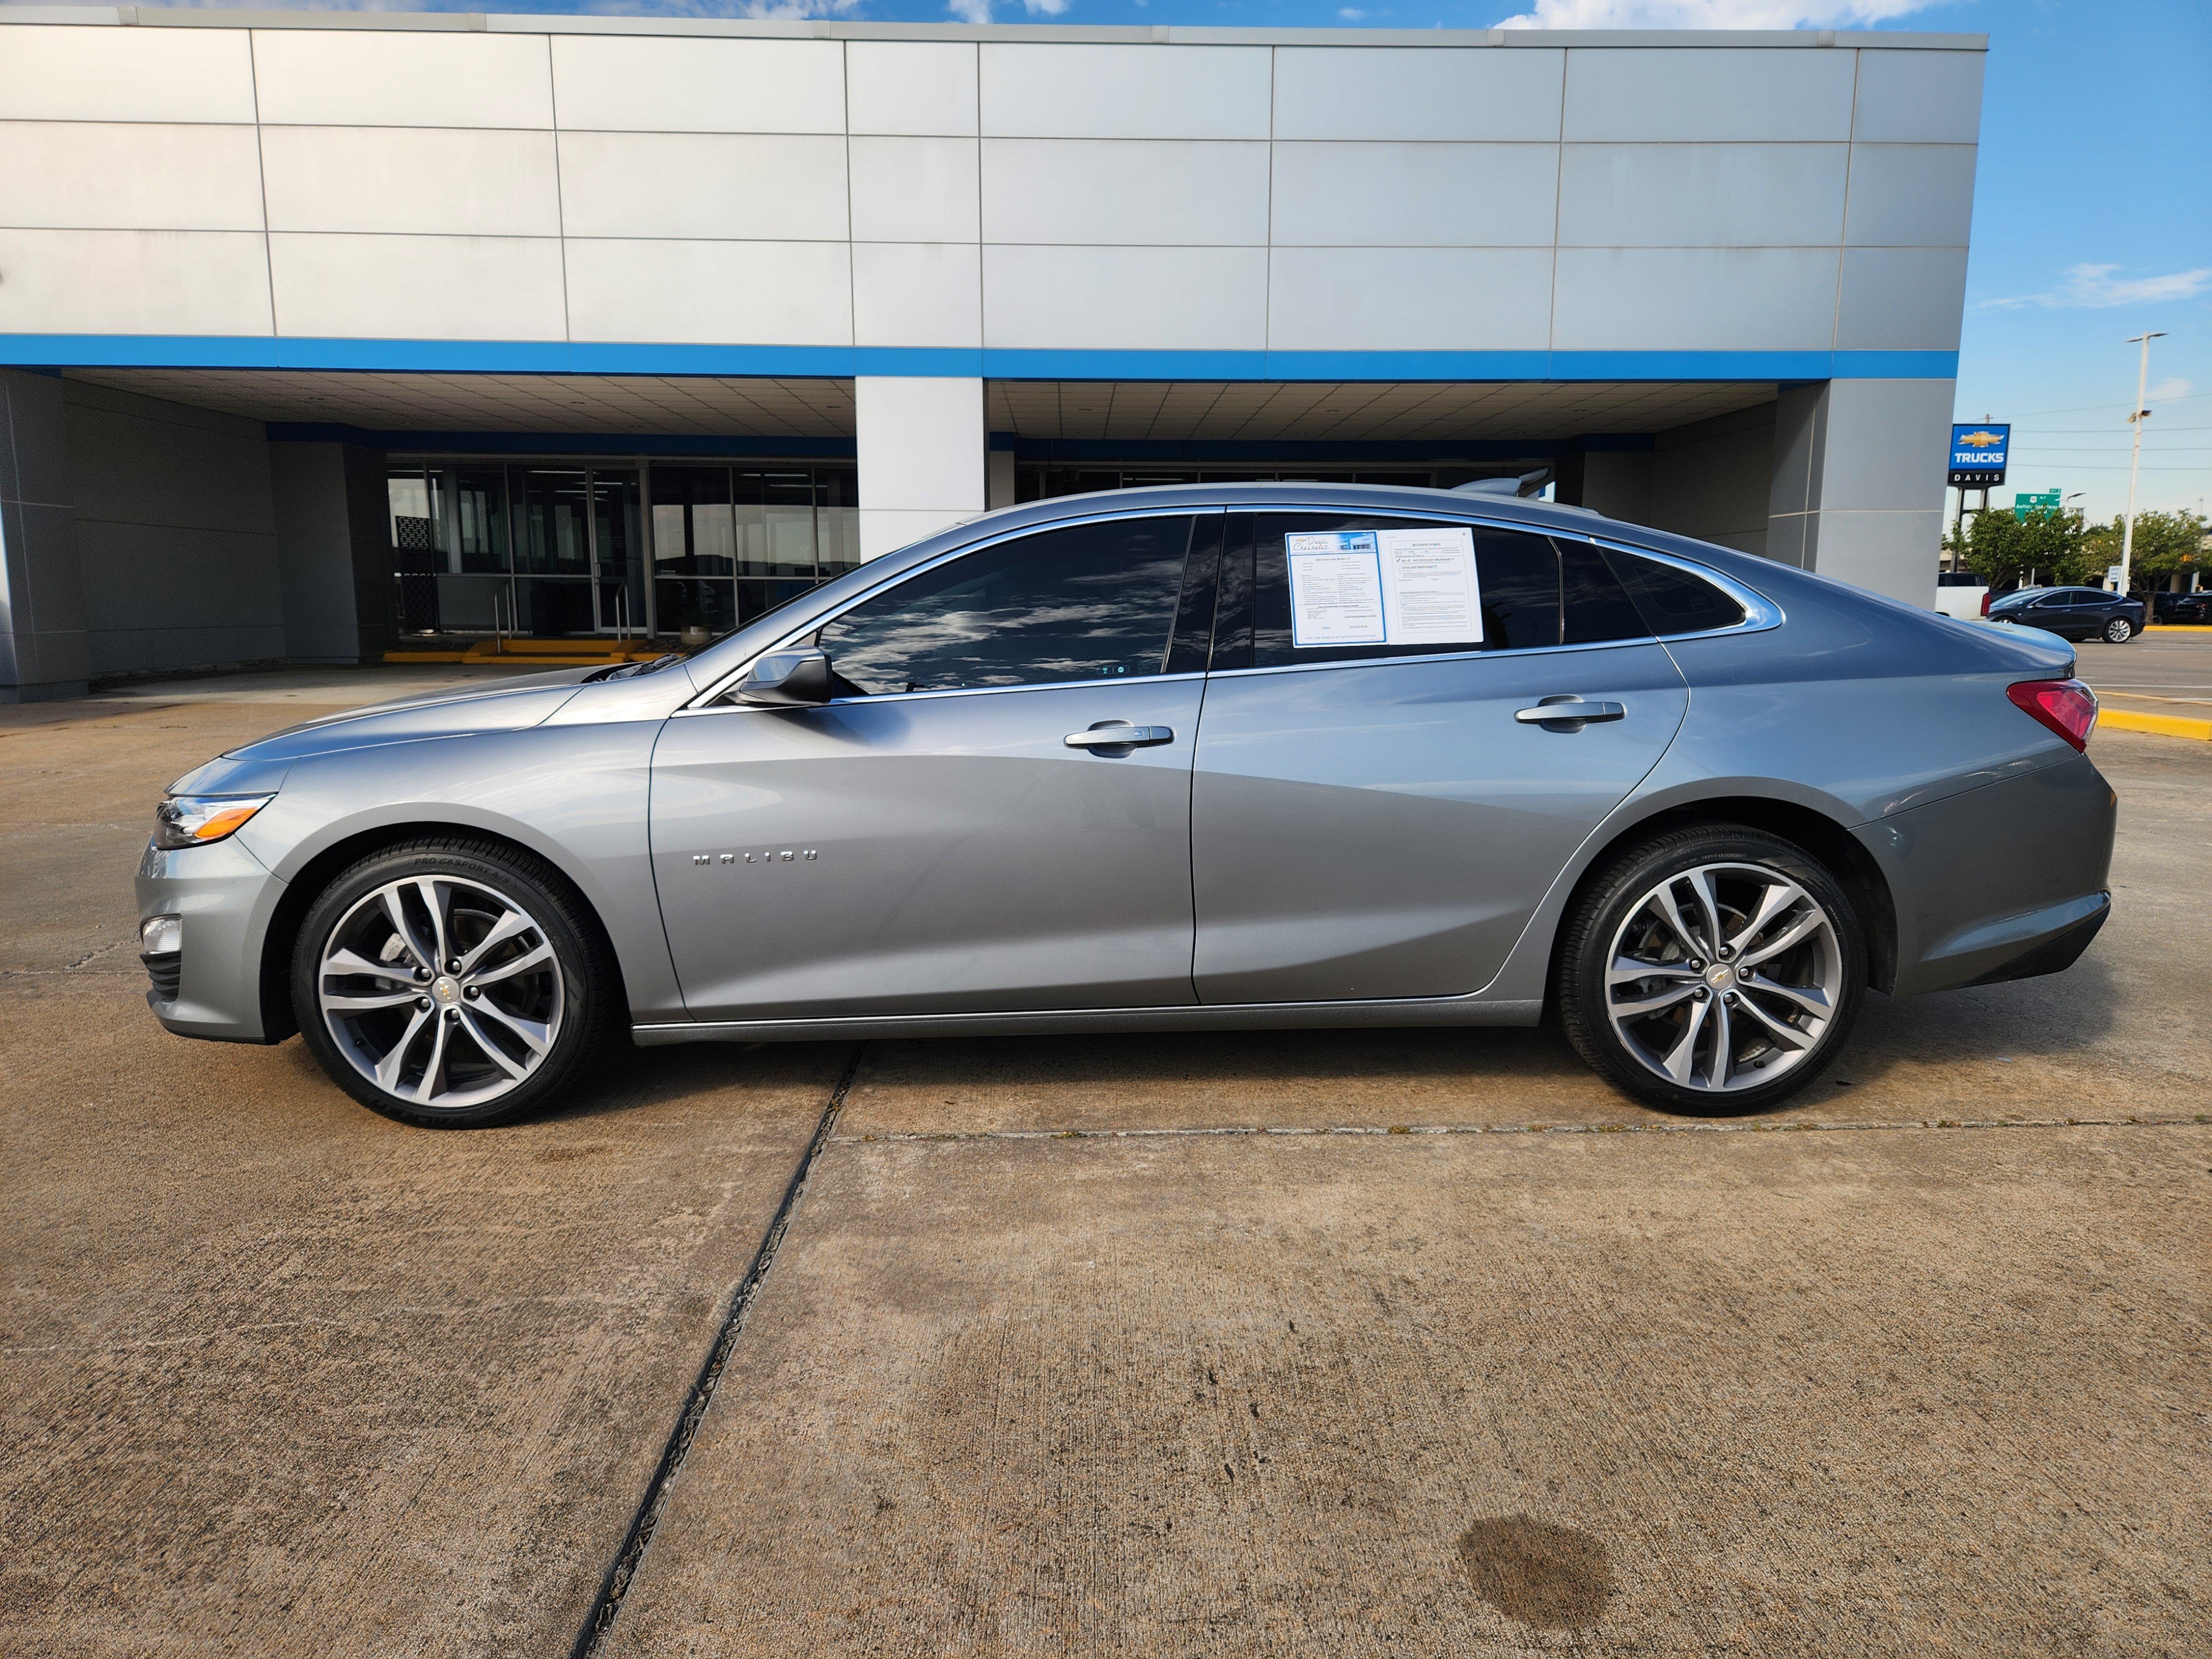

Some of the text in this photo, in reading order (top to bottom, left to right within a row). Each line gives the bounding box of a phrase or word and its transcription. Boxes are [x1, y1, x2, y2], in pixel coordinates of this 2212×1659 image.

[1954, 452, 2004, 463] TRUCKS
[1954, 473, 2000, 482] DAVIS
[1307, 536, 1328, 545] Davis
[1293, 542, 1329, 551] Chevrolet
[692, 850, 817, 865] MALIBU
